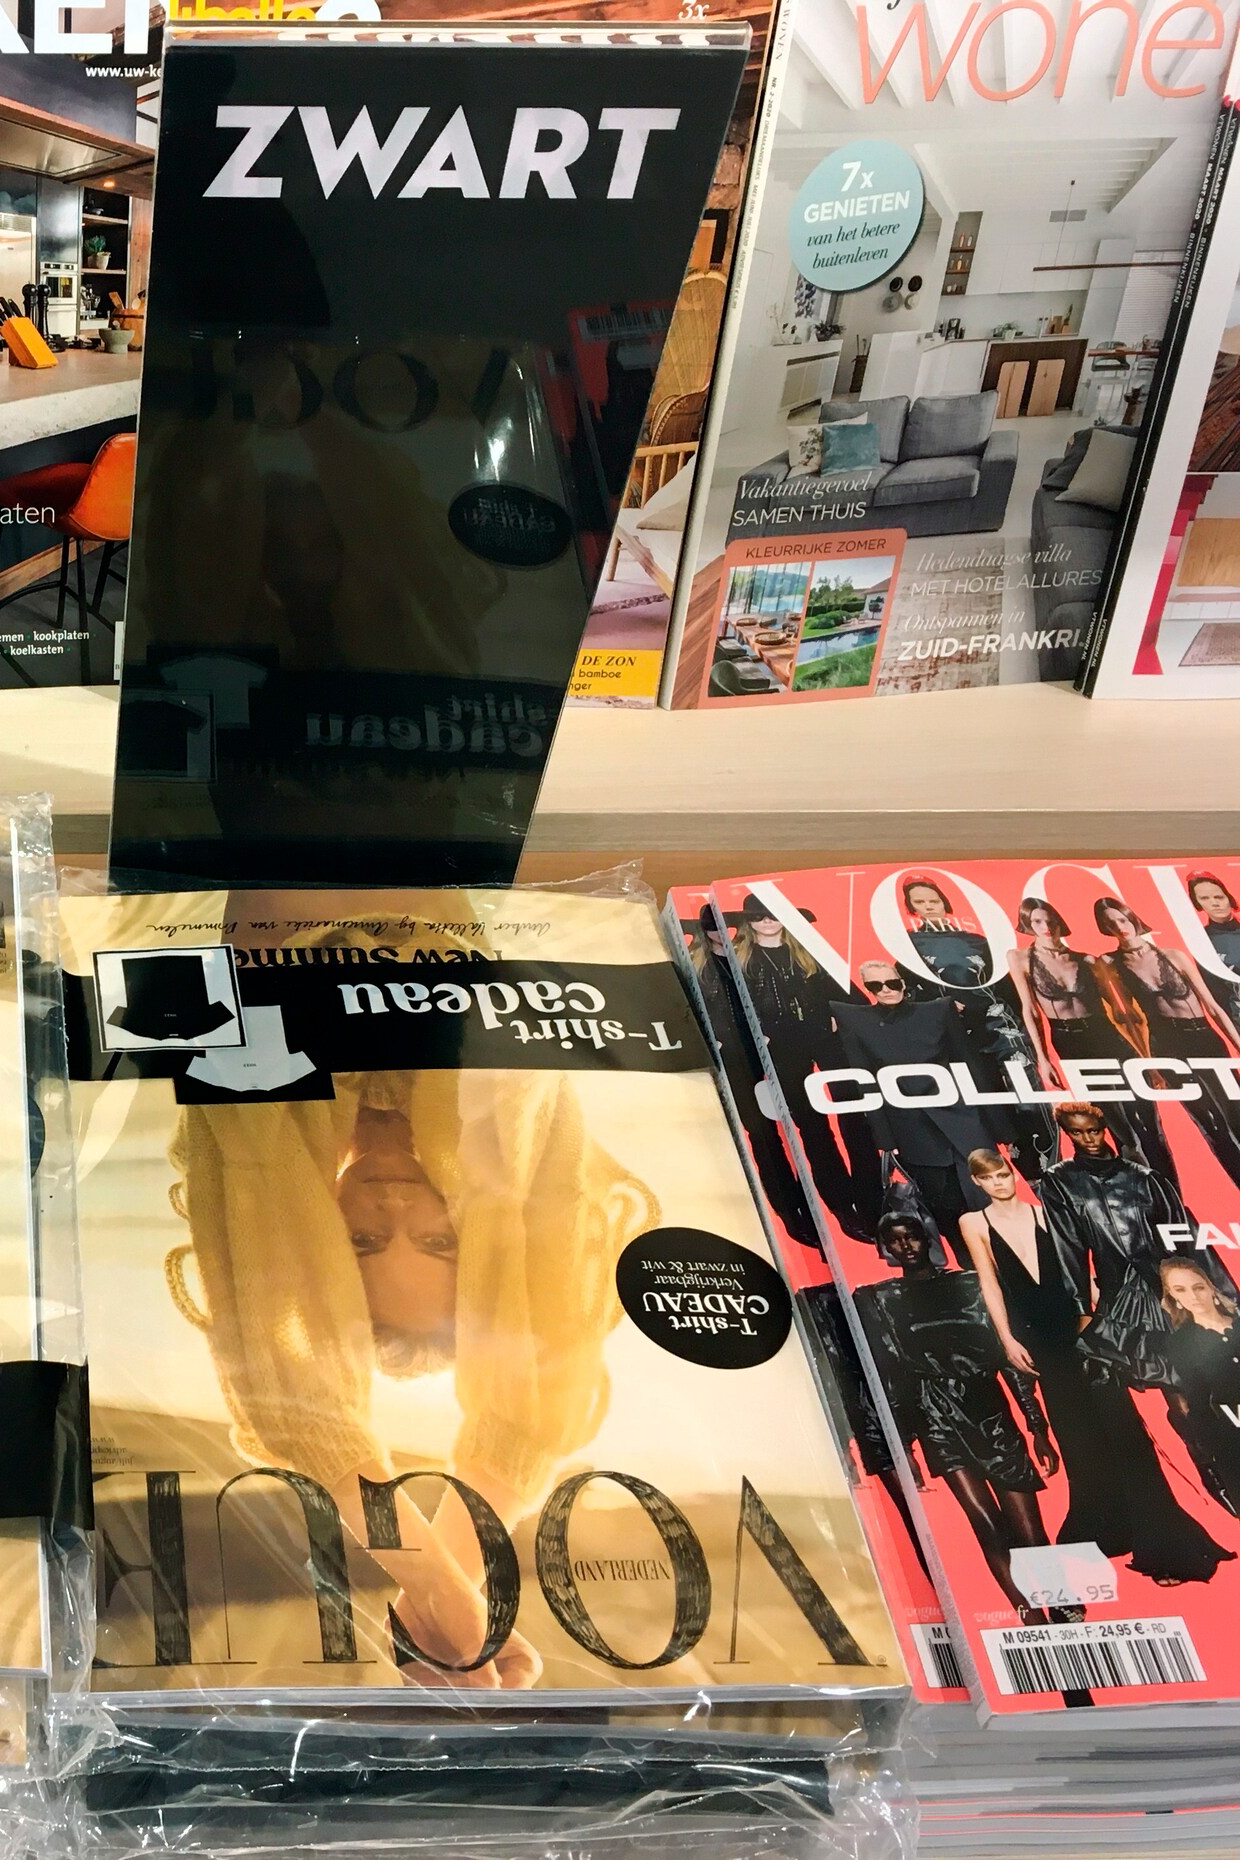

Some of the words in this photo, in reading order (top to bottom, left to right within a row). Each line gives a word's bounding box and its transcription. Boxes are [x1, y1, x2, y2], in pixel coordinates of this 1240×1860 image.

[678, 0, 708, 20] 3x
[202, 104, 681, 200] ZWART
[804, 190, 910, 223] GENIETEN
[1194, 198, 1204, 220] 2020
[1206, 202, 1216, 225] 2020
[807, 233, 832, 247] van
[836, 225, 858, 242] het
[861, 222, 900, 239] betere
[812, 246, 889, 269] buitenleven
[739, 471, 872, 500] Vakantiegevoel
[733, 506, 803, 526] SAMEN
[811, 502, 867, 521] THUIS
[746, 542, 832, 558] KLEURRIJKE
[836, 538, 887, 552] ZOMER
[916, 548, 1031, 572] Hedendaagse
[1034, 543, 1072, 564] villa
[910, 580, 951, 597] MET
[904, 612, 1003, 634] Ontspannen
[1008, 607, 1025, 624] in
[33, 630, 90, 645] kookplaten
[10, 645, 64, 656] koelkasten
[582, 655, 602, 666] DE
[606, 655, 637, 666] ZON
[579, 668, 622, 679] bamboe
[249, 921, 279, 930] van
[909, 916, 977, 933] PARIS
[338, 979, 607, 1033] cadeau
[512, 1018, 684, 1052] T-shirt
[641, 1260, 667, 1273] wit
[668, 1261, 684, 1273] &
[687, 1261, 728, 1272] zwart
[731, 1263, 746, 1276] in
[654, 1272, 744, 1291] Verkrijgbaar
[642, 1292, 770, 1315] CADEAU
[668, 1315, 758, 1336] T-shirt
[92, 1468, 879, 1672] VOGUE
[573, 1558, 673, 1582] NEDERLAND
[973, 1604, 1029, 1625] vogue.fr
[1003, 1631, 1014, 1644] M
[1016, 1629, 1051, 1643] 09541
[1059, 1627, 1078, 1641] 30H
[1098, 1624, 1132, 1639] 24,95
[1133, 1623, 1144, 1635] €
[1151, 1622, 1167, 1635] RD
